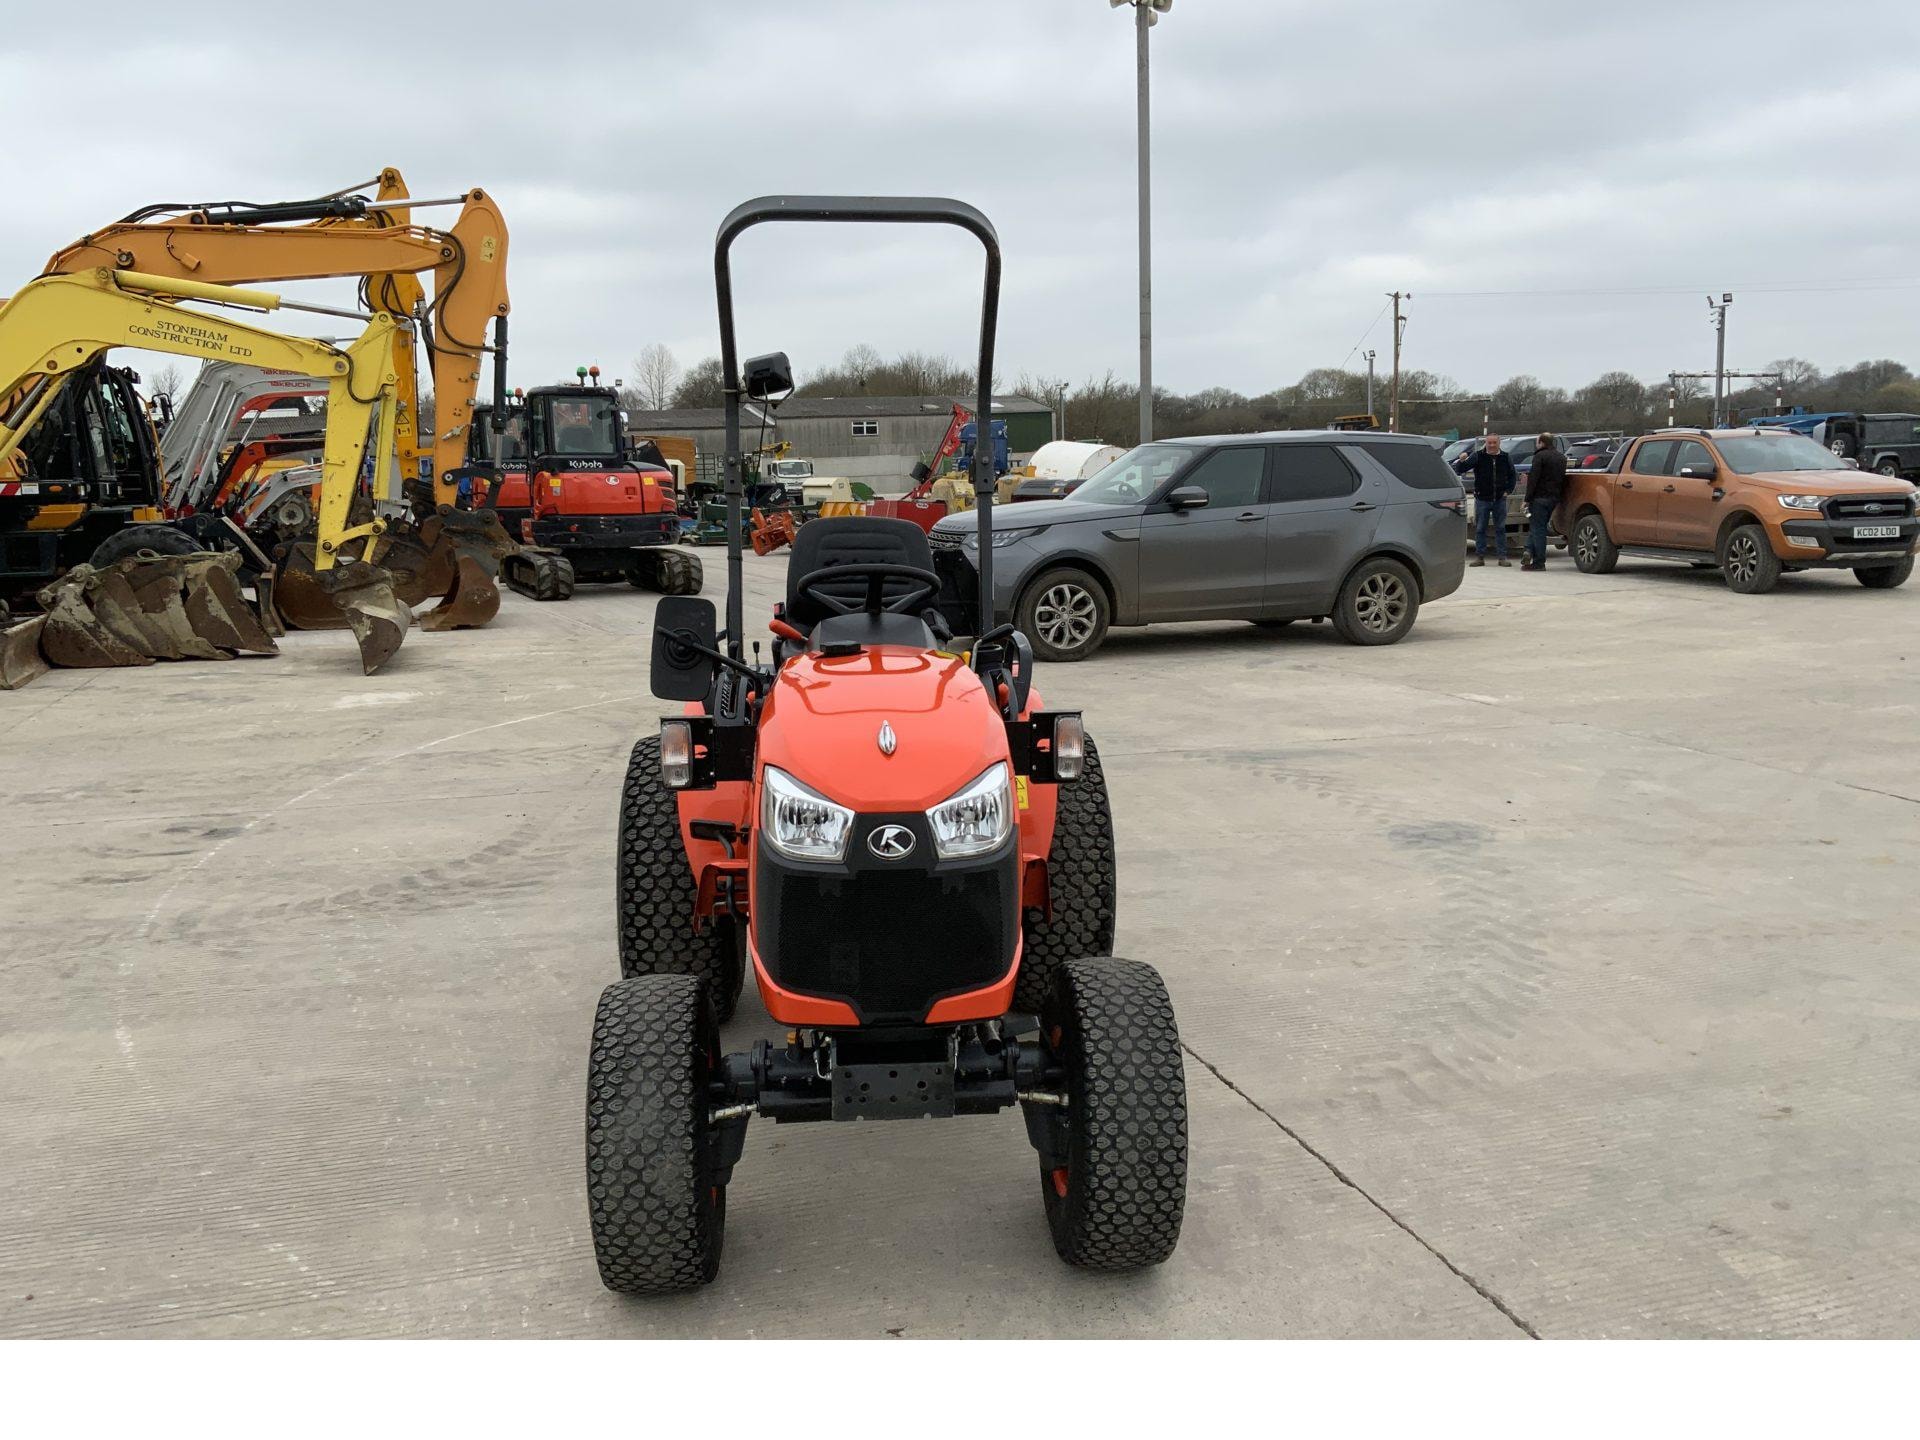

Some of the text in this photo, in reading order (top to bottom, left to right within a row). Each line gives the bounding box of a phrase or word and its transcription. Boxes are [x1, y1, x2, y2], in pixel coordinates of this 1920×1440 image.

[129, 324, 252, 357] CONSTRUCTION LTD
[157, 320, 229, 342] STONEHAM
[570, 460, 603, 469] Kubota
